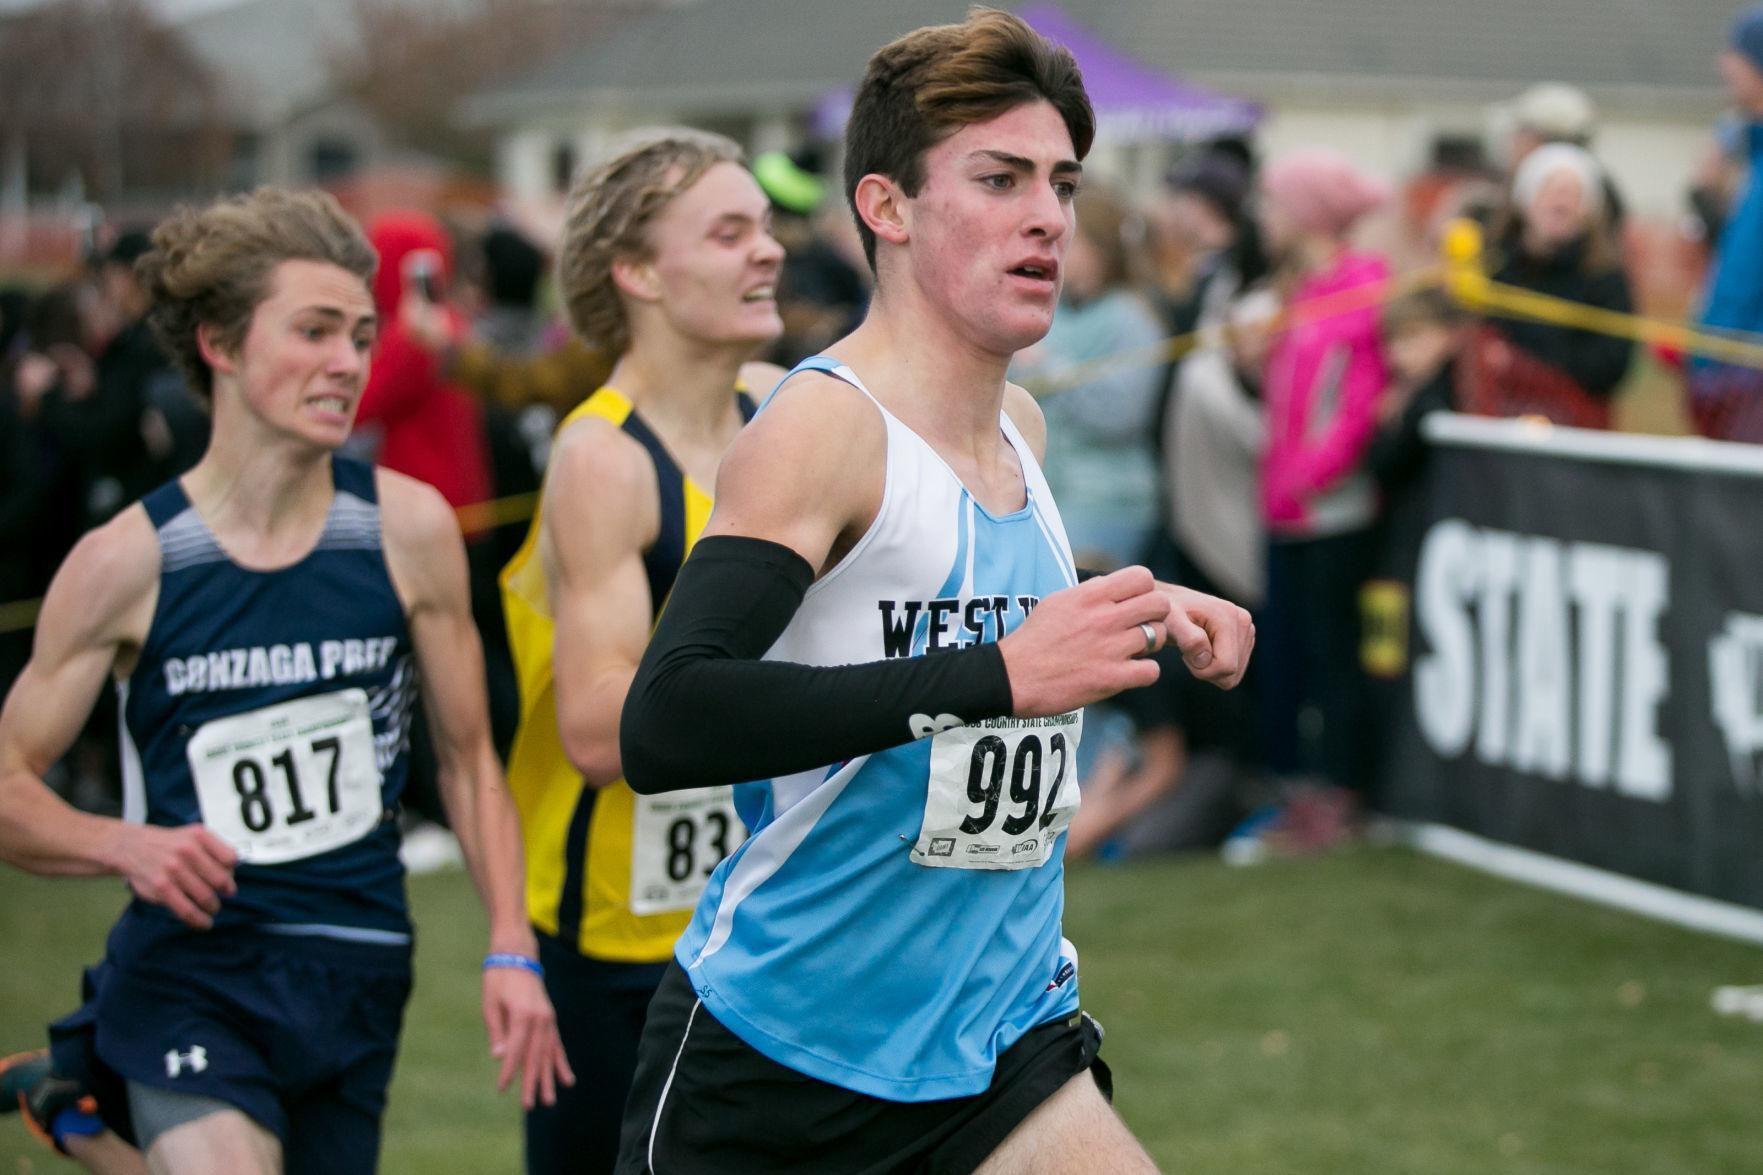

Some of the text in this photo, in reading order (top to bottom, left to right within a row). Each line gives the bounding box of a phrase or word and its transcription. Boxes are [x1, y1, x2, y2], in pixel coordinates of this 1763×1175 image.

[878, 597, 1008, 658] WEST
[1414, 518, 1671, 801] STATE
[164, 643, 317, 696] GONZAGA
[985, 717, 1020, 728] COUNTRY
[1022, 717, 1041, 728] STATE
[232, 736, 340, 833] 817
[959, 732, 1066, 835] 992
[668, 810, 728, 881] 83
